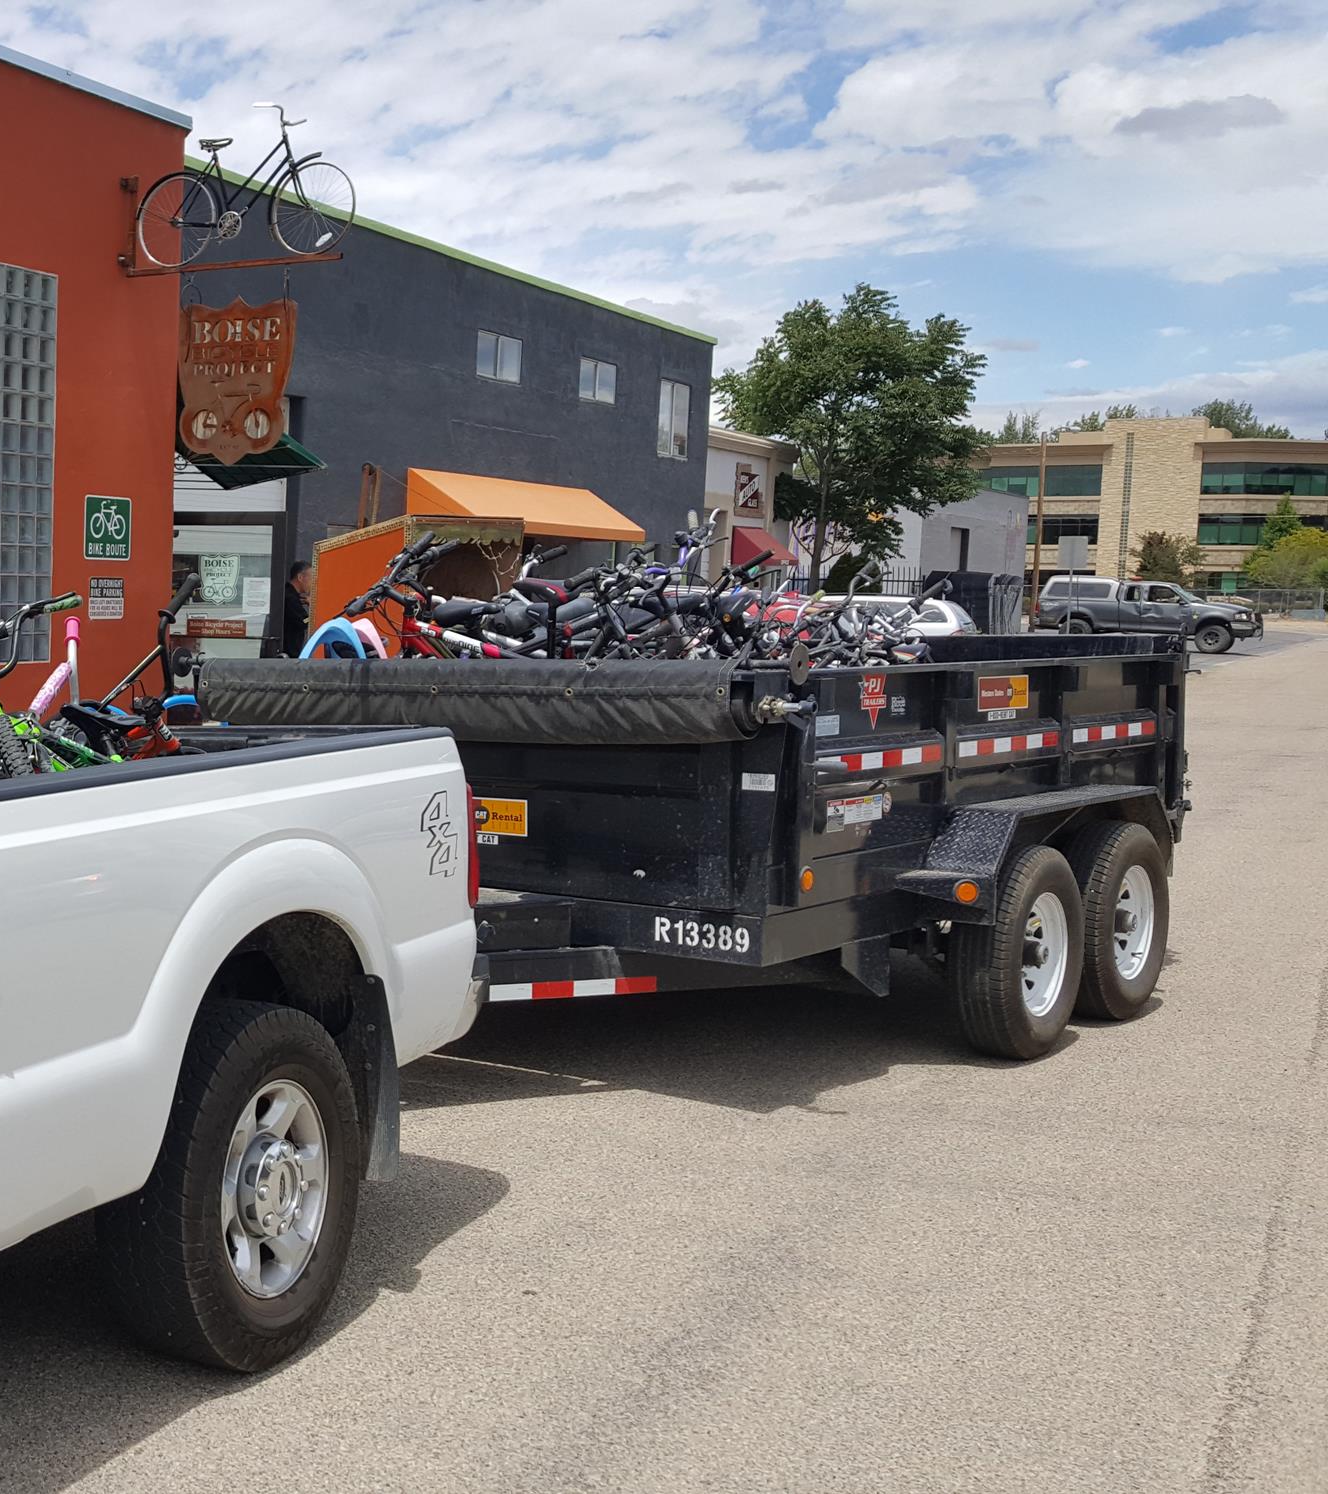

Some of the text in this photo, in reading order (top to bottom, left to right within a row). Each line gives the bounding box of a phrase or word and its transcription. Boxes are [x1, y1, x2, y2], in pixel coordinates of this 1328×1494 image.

[192, 317, 281, 344] BOISE
[193, 361, 276, 377] PROJECT
[88, 543, 127, 556] BIKE ROUTE
[204, 559, 234, 567] BOISE
[91, 580, 122, 588] NO OVERNIGHT
[91, 589, 122, 597] BIKE PARKING
[205, 621, 224, 629] Bicycle
[225, 621, 243, 630] Project
[868, 678, 881, 693] PJ
[863, 698, 885, 706] TRAILERS
[492, 811, 522, 823] Rental
[481, 835, 495, 844] CAT
[654, 916, 750, 953] R13389
